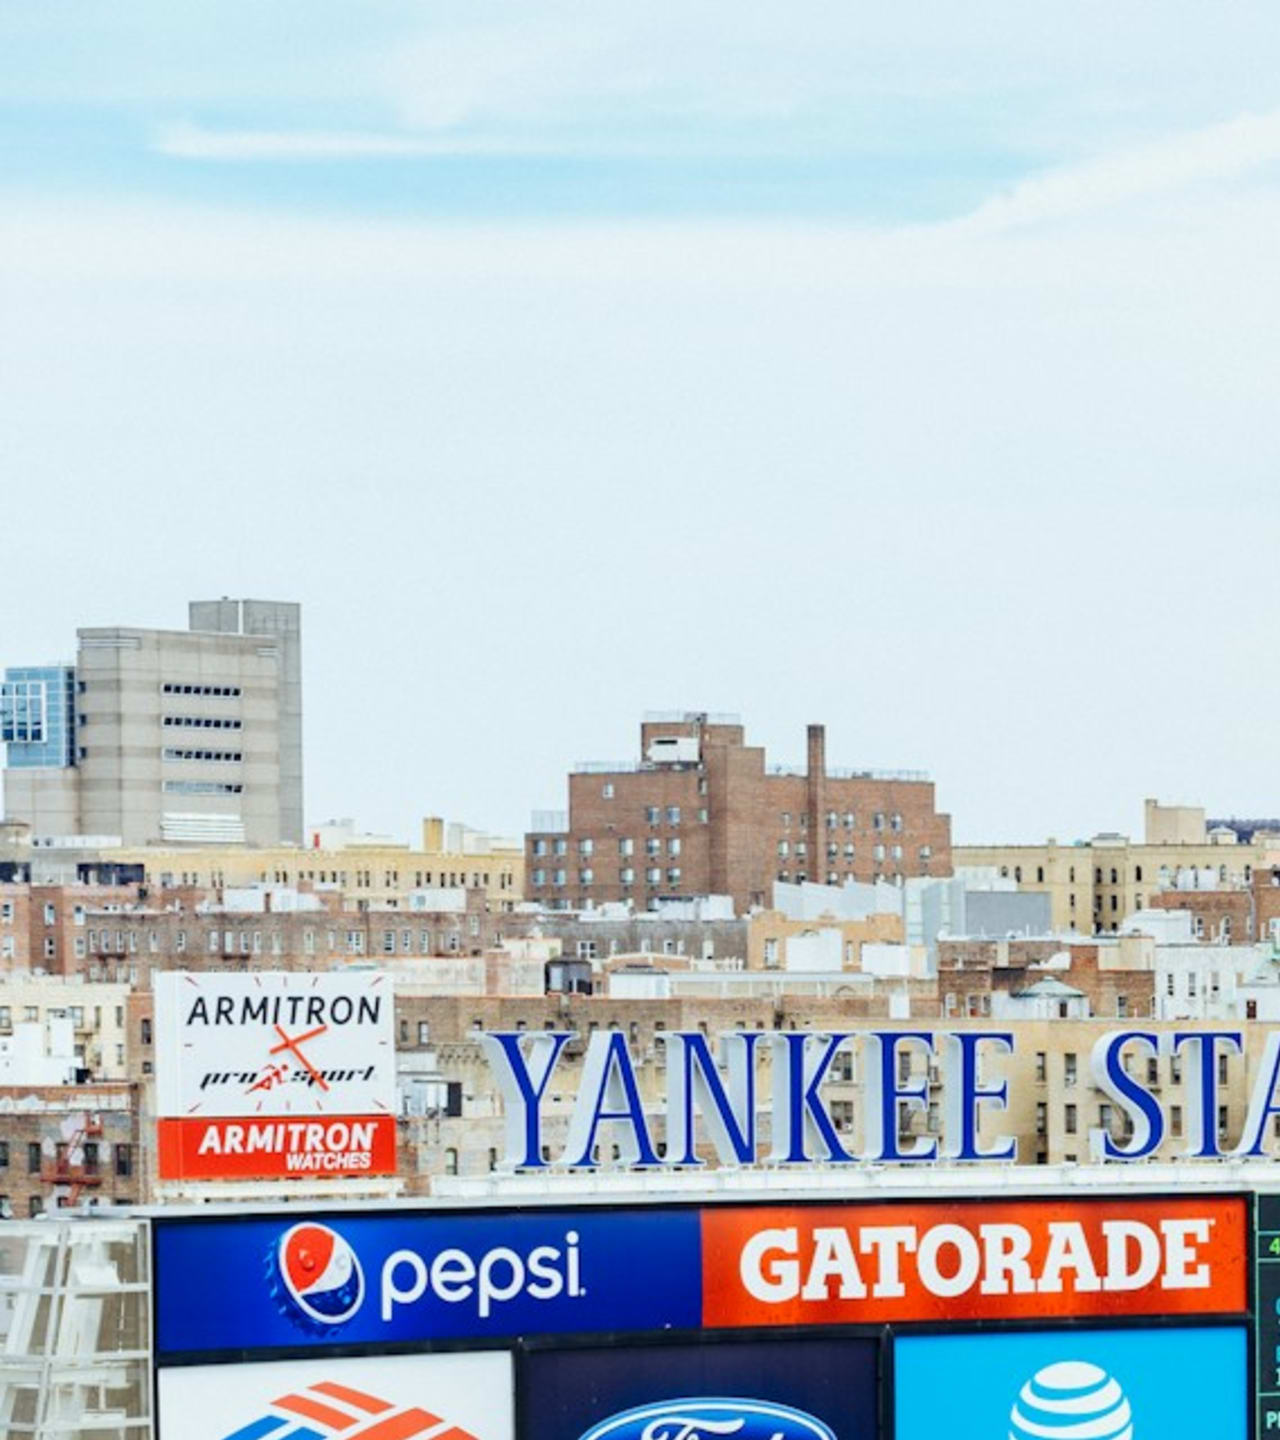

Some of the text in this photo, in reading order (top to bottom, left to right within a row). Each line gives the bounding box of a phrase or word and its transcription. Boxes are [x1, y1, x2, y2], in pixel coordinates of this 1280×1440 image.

[186, 996, 381, 1026] ARMITRON
[480, 1030, 1016, 1170] YANKEE
[198, 1122, 379, 1155] ARMITRON
[286, 1152, 372, 1171] WATCHES
[379, 1229, 581, 1321] pepsi
[737, 1216, 1212, 1304] GATORADE
